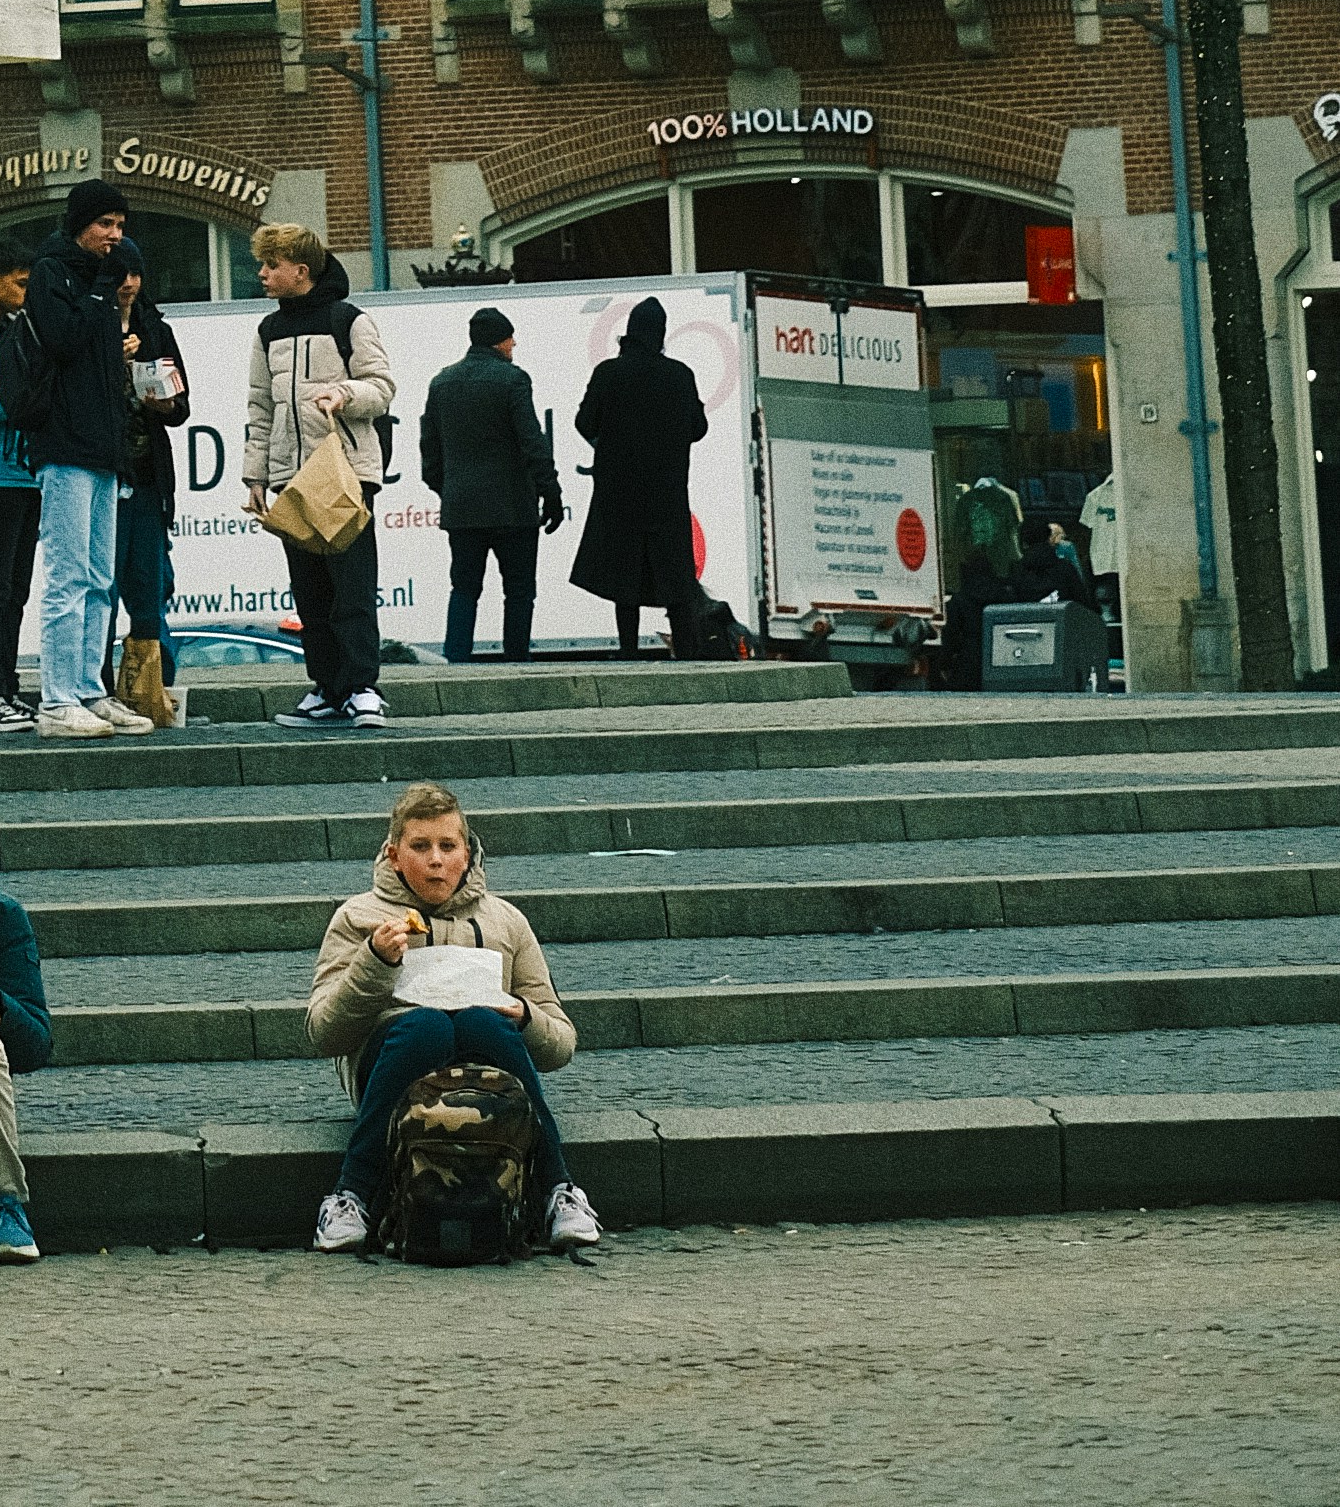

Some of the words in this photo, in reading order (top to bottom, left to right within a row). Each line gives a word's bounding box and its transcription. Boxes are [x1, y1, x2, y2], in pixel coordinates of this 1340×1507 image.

[646, 113, 728, 146] 100%
[730, 107, 874, 135] HOLLAND
[113, 136, 272, 208] Souvenirs
[819, 331, 902, 364] DELICIOUS
